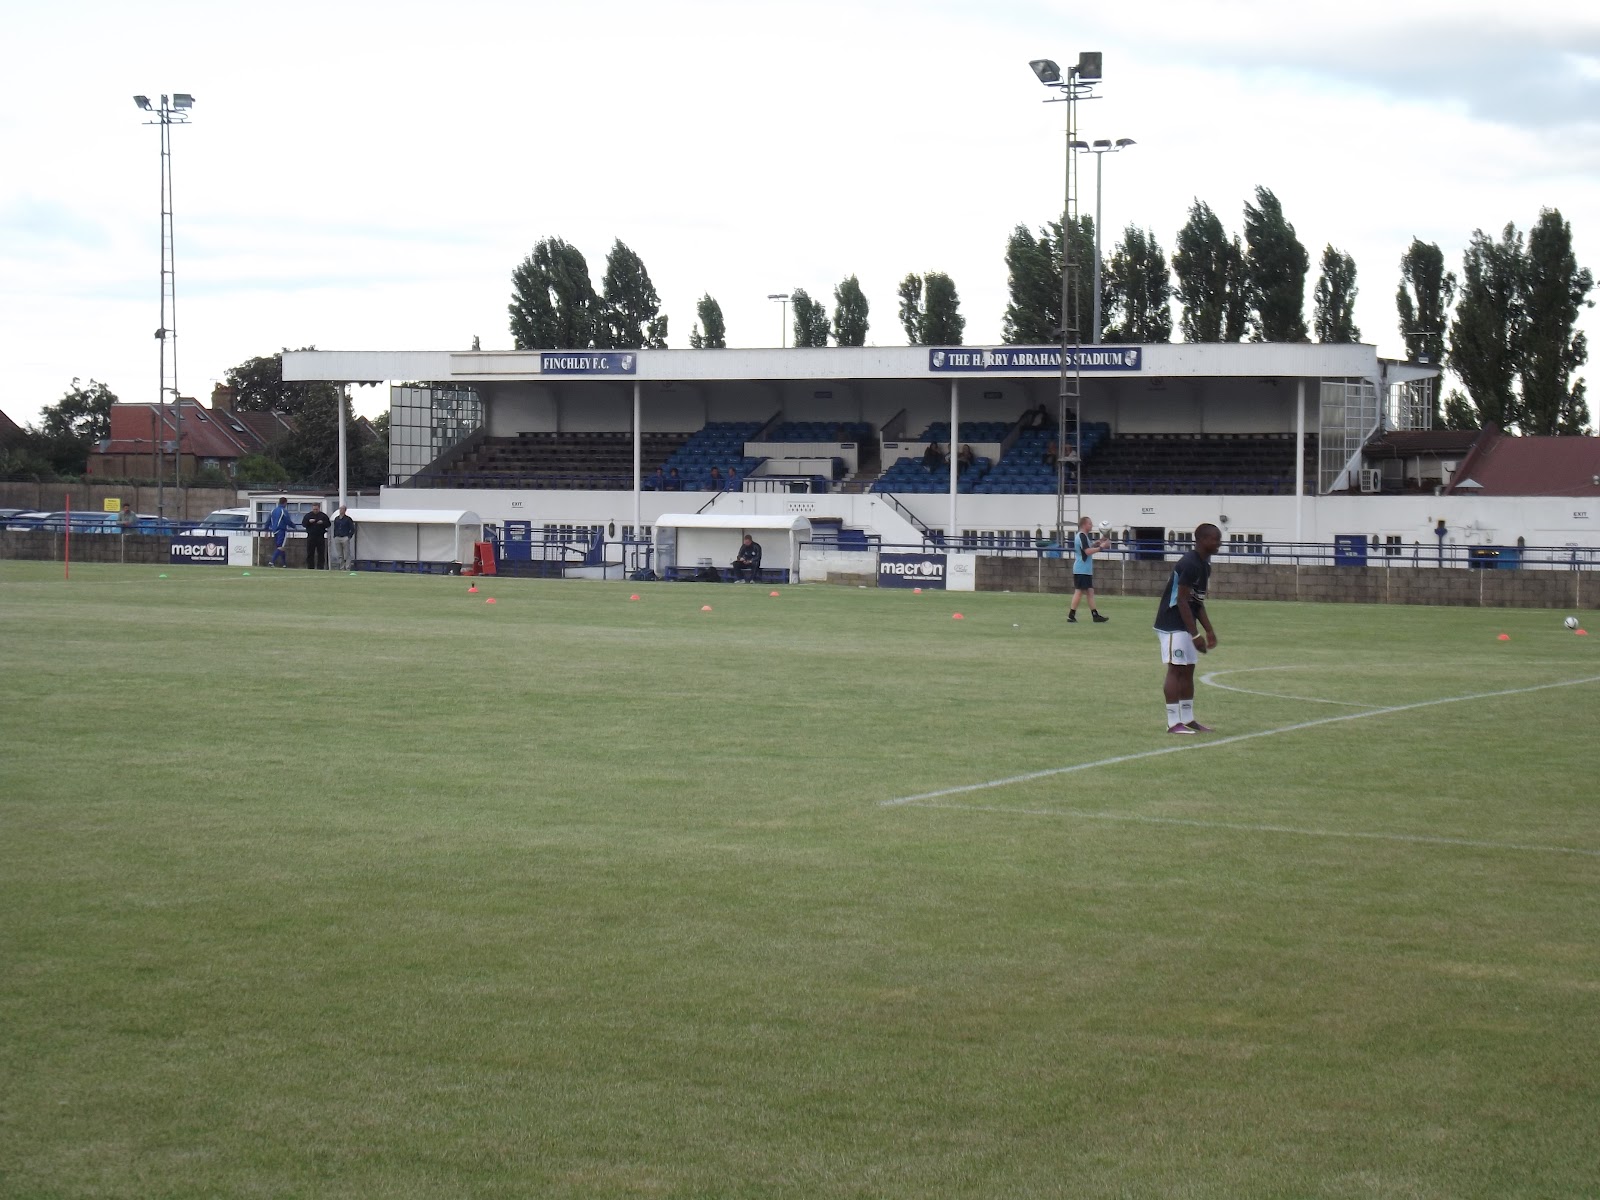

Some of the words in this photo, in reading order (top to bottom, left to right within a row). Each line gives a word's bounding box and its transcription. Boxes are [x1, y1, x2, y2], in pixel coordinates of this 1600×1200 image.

[543, 357, 591, 370] FINCHLEY
[592, 357, 610, 370] F.C.
[948, 353, 970, 366] THE
[171, 543, 225, 557] macron
[880, 561, 944, 576] macron
